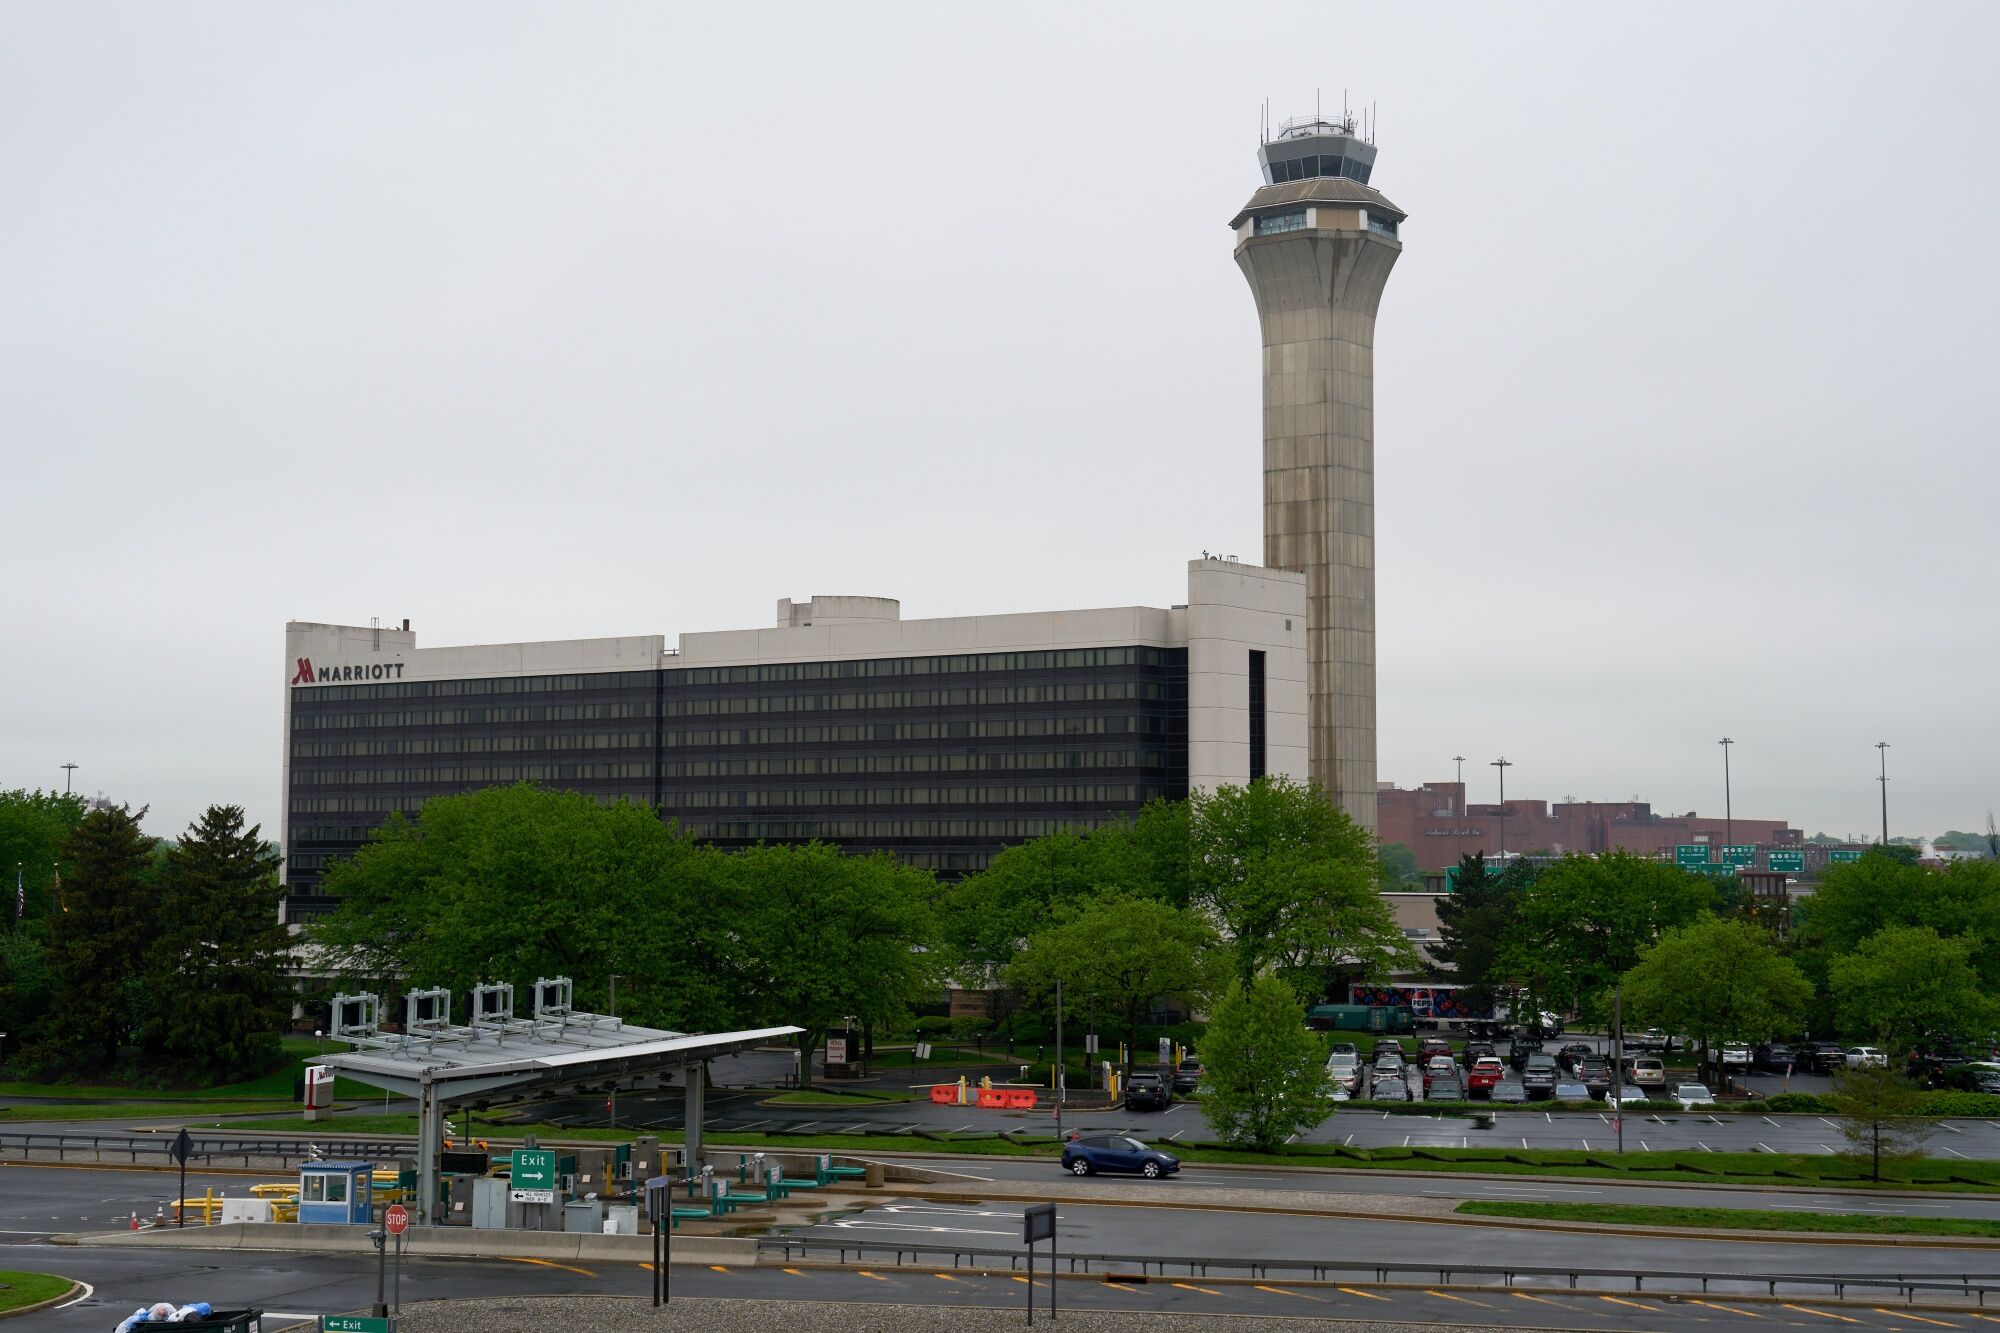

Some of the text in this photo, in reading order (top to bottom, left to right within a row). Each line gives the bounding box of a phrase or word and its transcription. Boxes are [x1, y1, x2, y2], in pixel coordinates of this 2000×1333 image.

[318, 663, 404, 682] MARRIOTT
[521, 1154, 545, 1166] Exit
[387, 1213, 407, 1226] STOP
[343, 1320, 361, 1330] Exit
